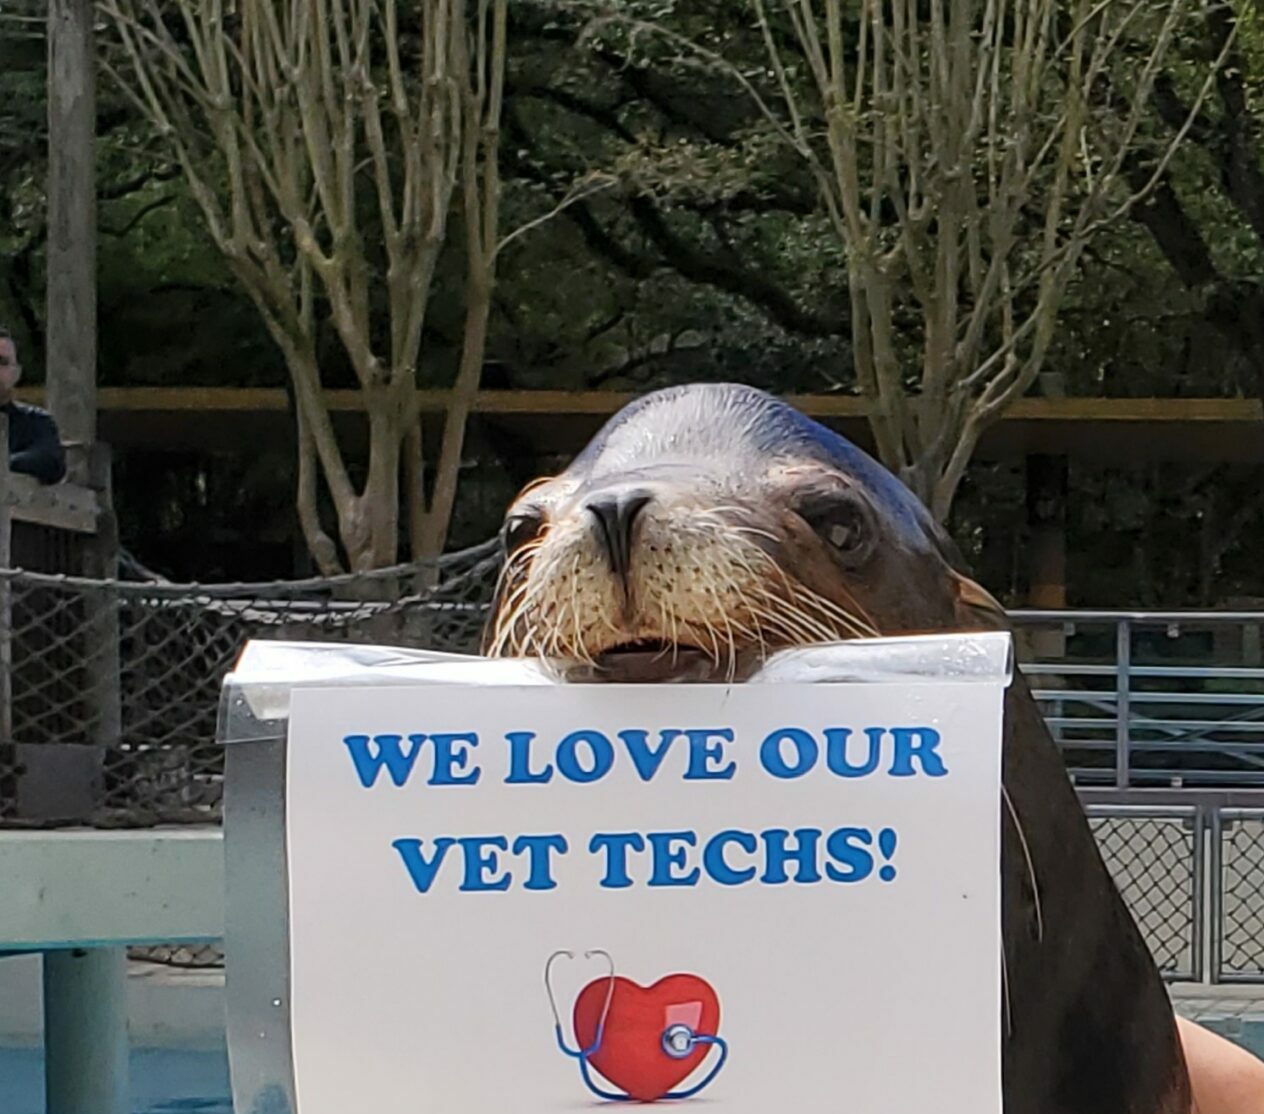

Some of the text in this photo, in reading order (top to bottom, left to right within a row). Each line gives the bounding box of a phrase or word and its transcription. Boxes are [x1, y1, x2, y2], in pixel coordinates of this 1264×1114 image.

[343, 726, 949, 788] WE LOVE OUR
[392, 827, 898, 893] VET TECHS!
